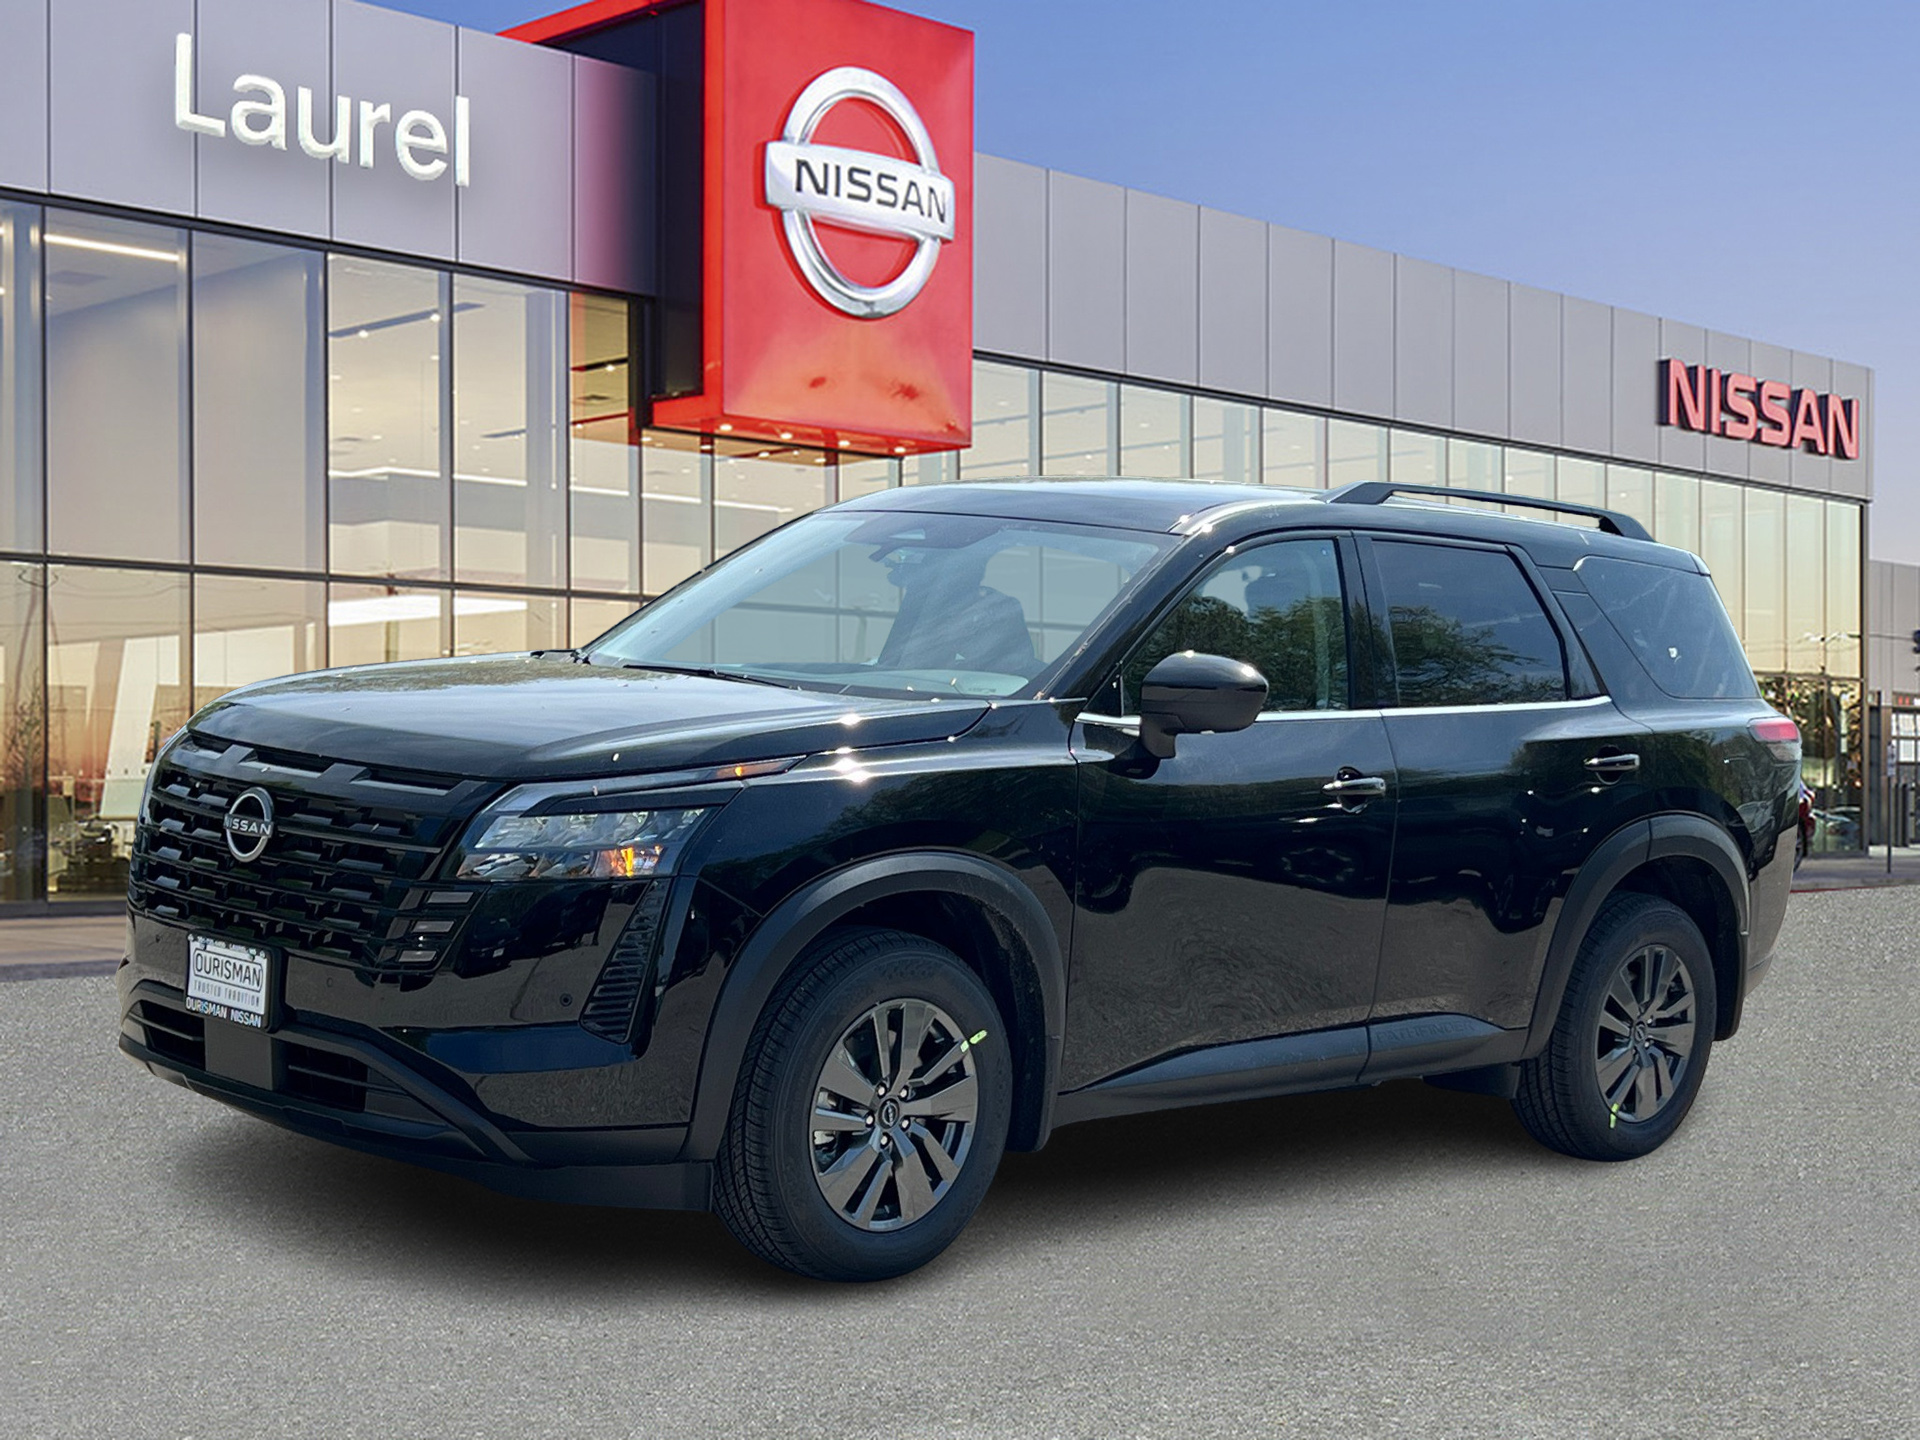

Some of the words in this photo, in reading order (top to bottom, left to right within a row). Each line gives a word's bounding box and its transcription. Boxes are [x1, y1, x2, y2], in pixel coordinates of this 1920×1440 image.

[175, 32, 469, 187] Laurel
[795, 158, 947, 224] NISSAN
[1664, 358, 1859, 460] NISSAN
[225, 813, 272, 835] NISSAN
[195, 952, 262, 988] OURISMAN
[193, 980, 221, 998] TRUSTED
[185, 996, 228, 1019] OURISMAN
[230, 1009, 262, 1028] NISSAN
